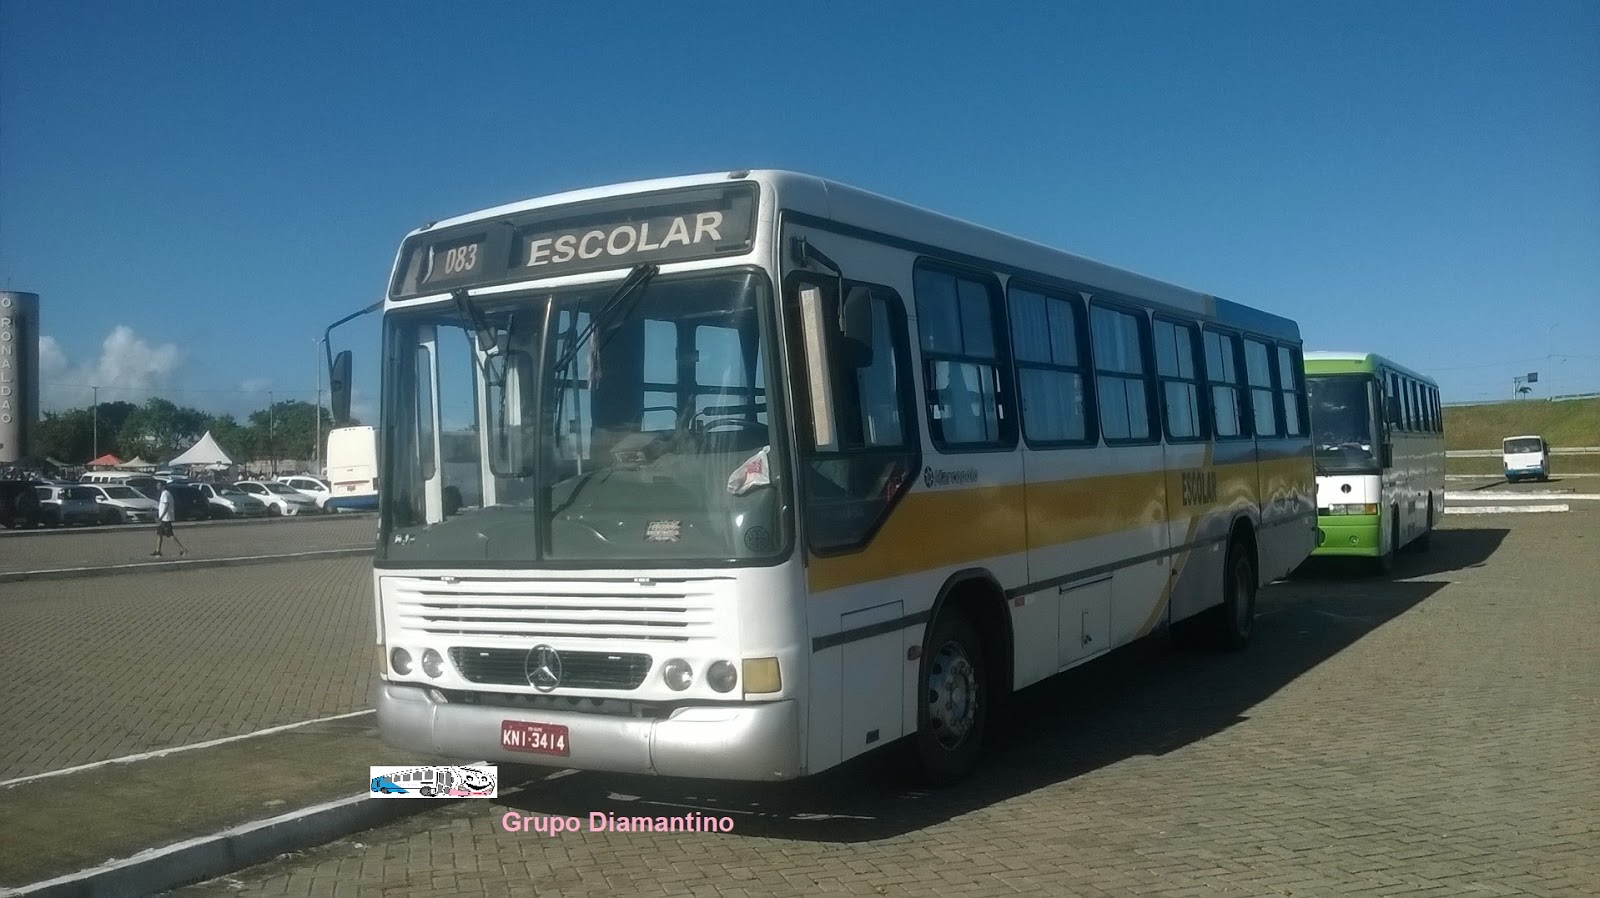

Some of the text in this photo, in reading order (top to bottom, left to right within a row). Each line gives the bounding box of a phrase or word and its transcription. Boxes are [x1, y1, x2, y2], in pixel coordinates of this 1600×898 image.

[526, 211, 723, 267] ESCOLAR
[445, 243, 478, 275] 083
[1182, 471, 1217, 506] ESCOLAR
